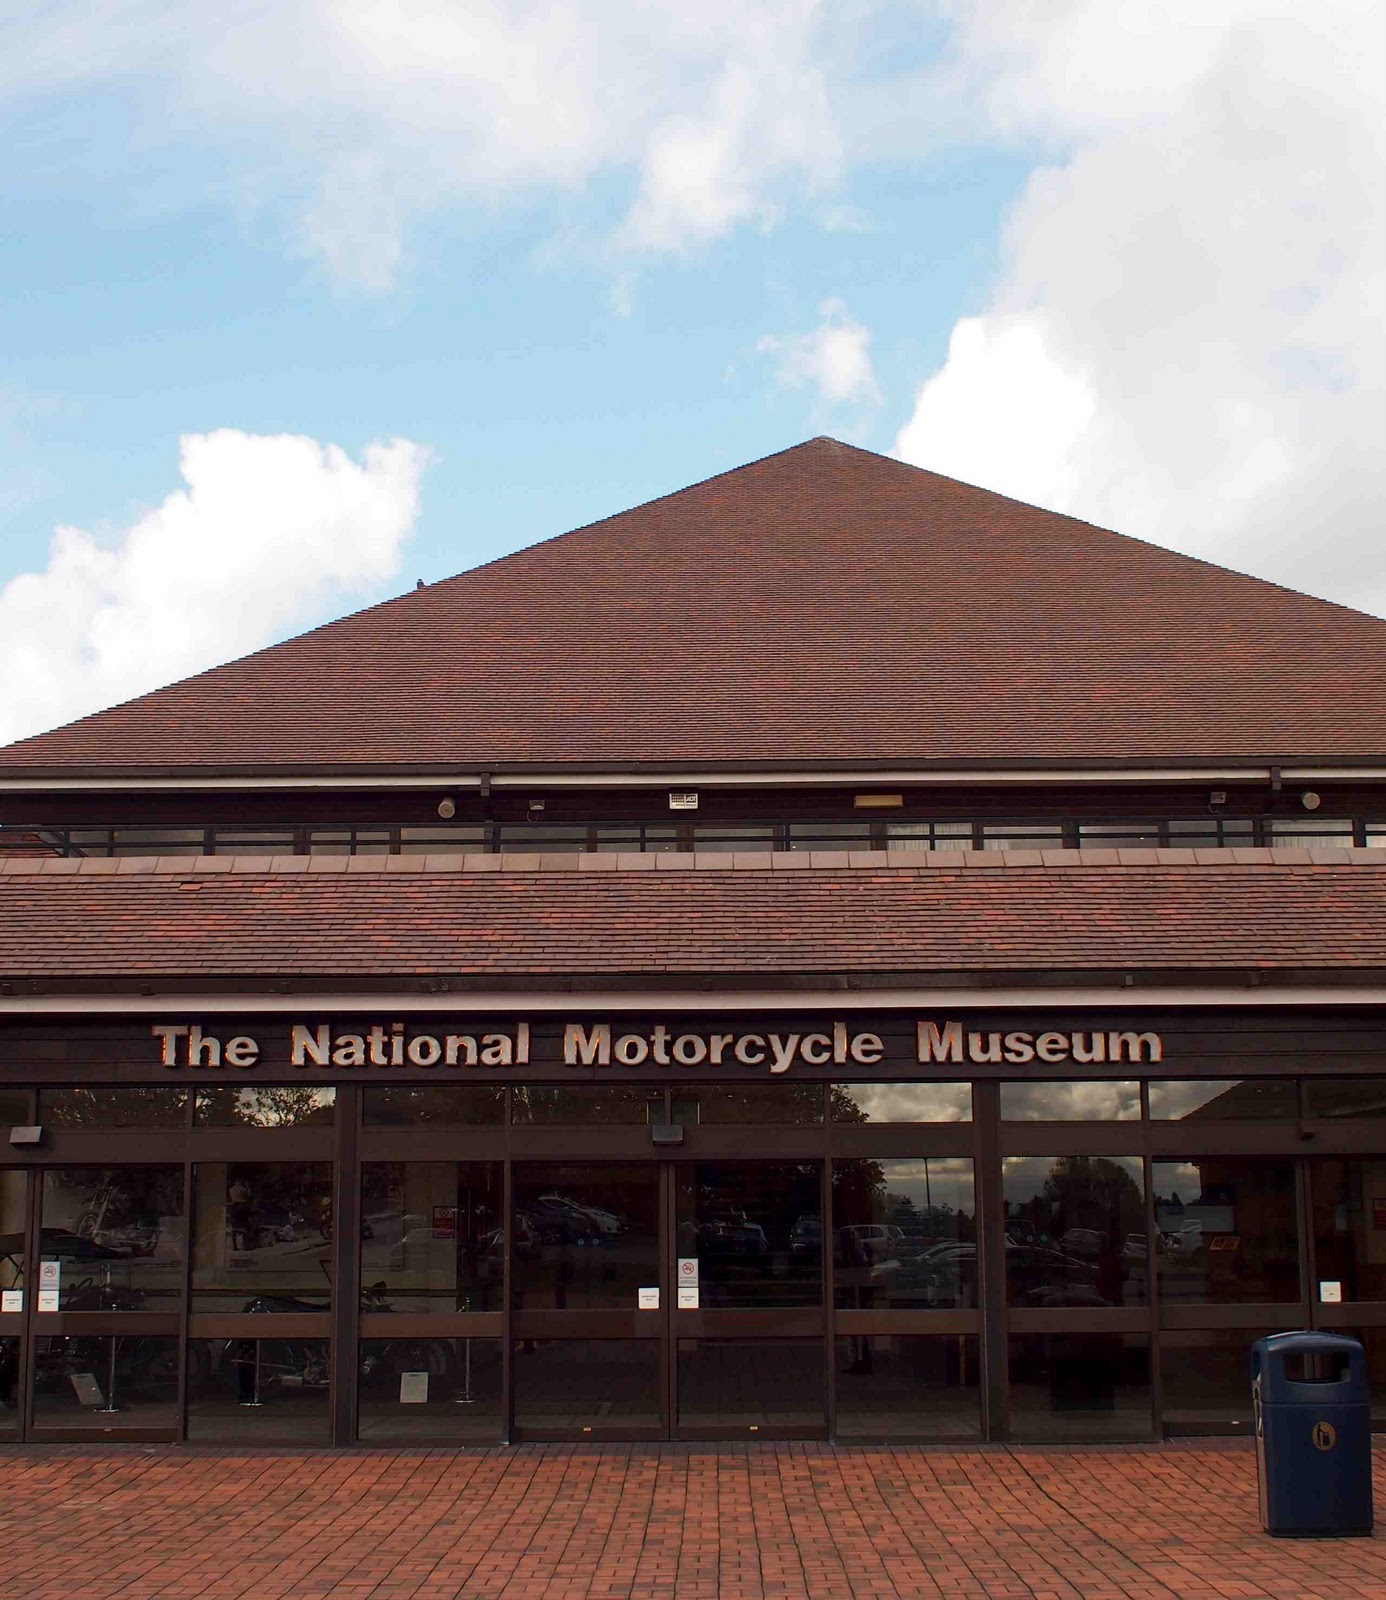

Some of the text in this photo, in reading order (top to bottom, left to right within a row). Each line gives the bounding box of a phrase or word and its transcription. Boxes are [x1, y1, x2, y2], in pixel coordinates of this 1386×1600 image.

[152, 1021, 1163, 1074] The National Motorcycle Museum
